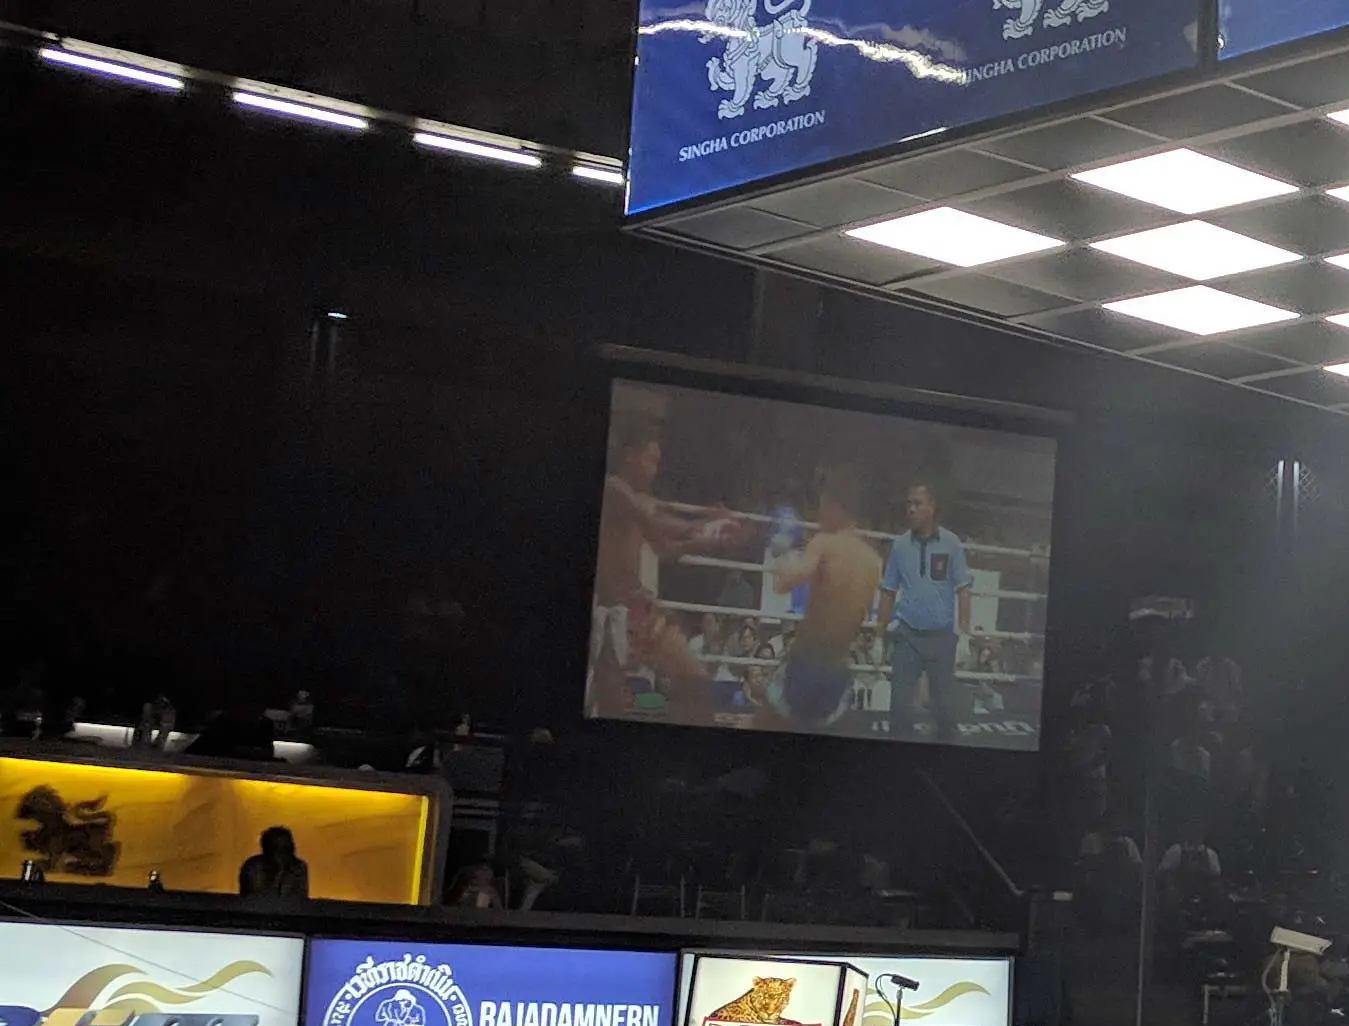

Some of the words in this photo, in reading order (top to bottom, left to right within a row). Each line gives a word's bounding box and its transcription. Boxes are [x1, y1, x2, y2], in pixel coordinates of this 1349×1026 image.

[959, 58, 1014, 86] INGHA
[1017, 27, 1127, 70] CORPORATION
[678, 136, 728, 162] SINGHA
[730, 110, 826, 148] CORPORATION
